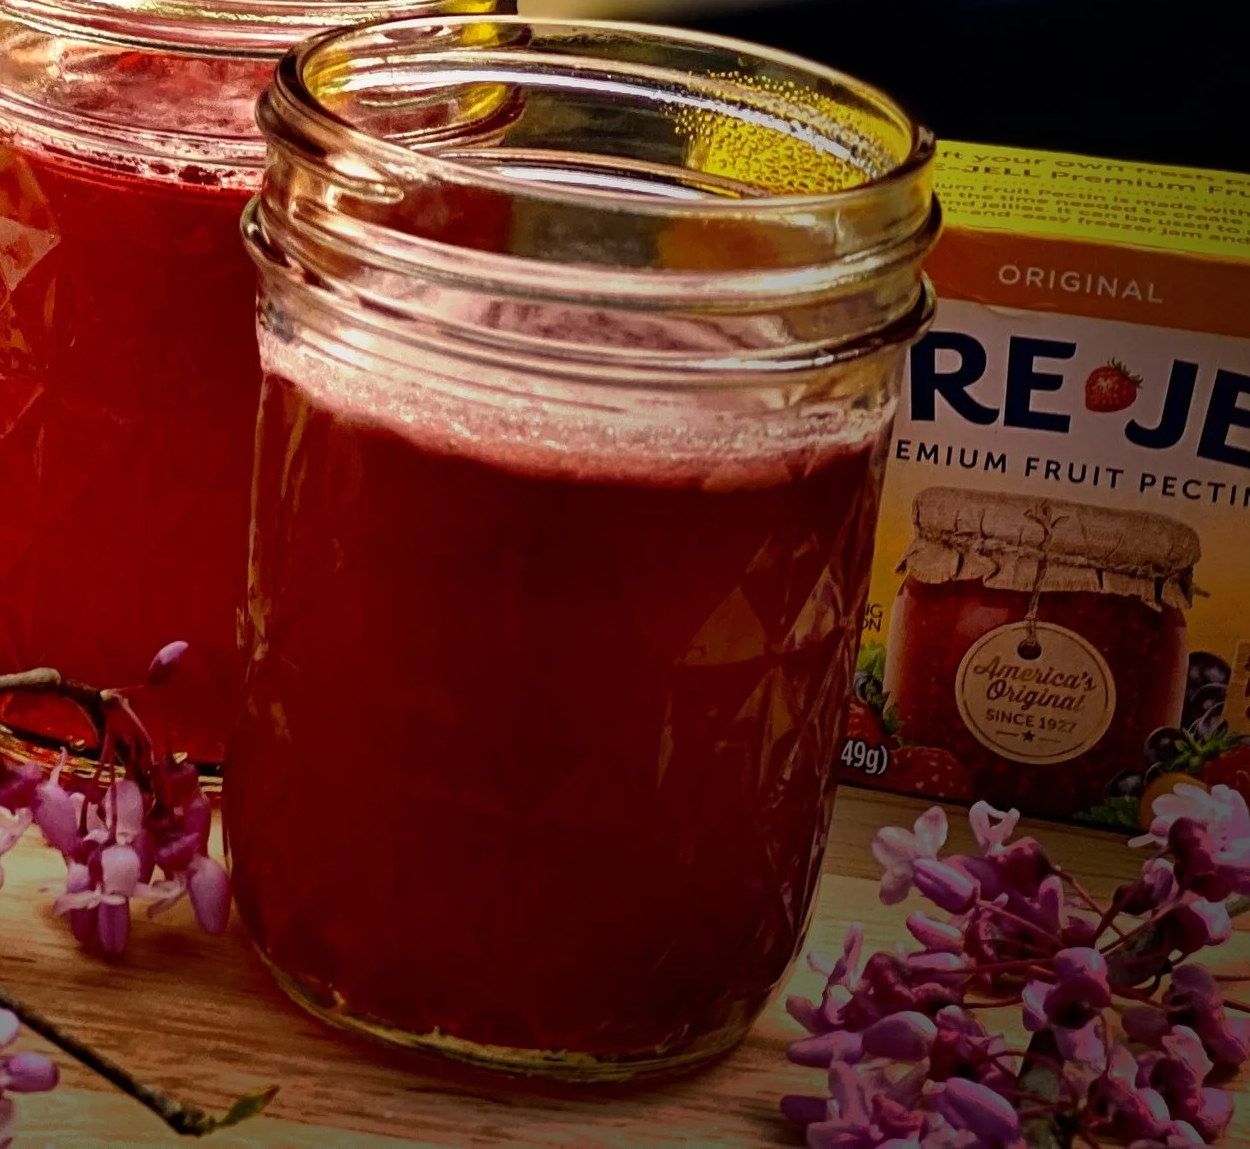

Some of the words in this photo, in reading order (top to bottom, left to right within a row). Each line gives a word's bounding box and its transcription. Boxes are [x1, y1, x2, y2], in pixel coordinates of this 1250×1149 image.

[973, 154, 1047, 165] your
[1055, 160, 1125, 171] own
[1051, 171, 1196, 192] Premium
[959, 192, 994, 200] the
[1001, 195, 1049, 204] time
[1056, 200, 1137, 213] needed
[1144, 208, 1167, 216] to
[1173, 212, 1243, 225] create
[983, 185, 1031, 195] Fruit
[1038, 189, 1106, 201] Pectin
[1136, 200, 1197, 211] made
[1077, 216, 1156, 233] freezer
[1160, 227, 1202, 239] jam
[1125, 214, 1152, 224] be
[1158, 219, 1210, 230] used
[1218, 225, 1240, 234] to
[998, 264, 1164, 304] ORIGINAL
[1024, 457, 1125, 489] FRUIT
[973, 656, 1098, 692] America's
[986, 679, 1087, 713] Original
[985, 707, 1035, 728] SINCE
[1038, 716, 1078, 734] 1927
